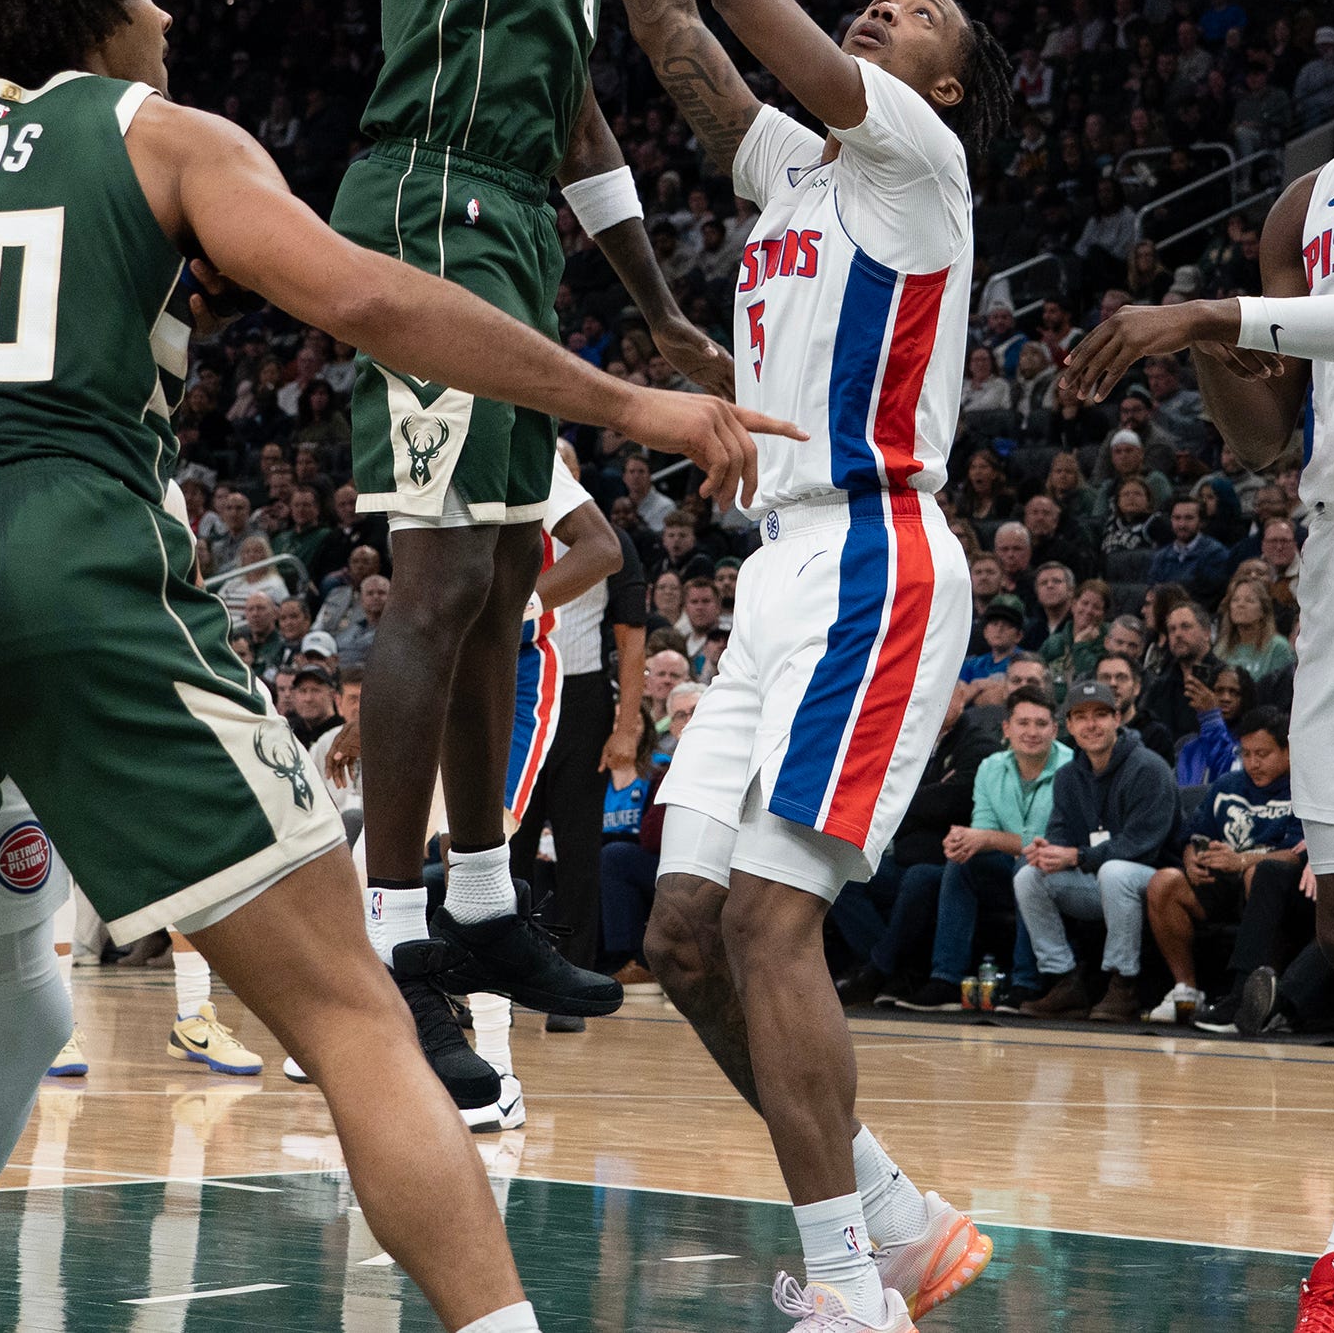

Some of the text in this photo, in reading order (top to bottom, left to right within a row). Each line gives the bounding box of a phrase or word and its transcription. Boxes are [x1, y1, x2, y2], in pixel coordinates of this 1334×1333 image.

[746, 299, 765, 382] 5
[5, 839, 43, 863] DETROIT
[8, 849, 46, 875] PISTONS
